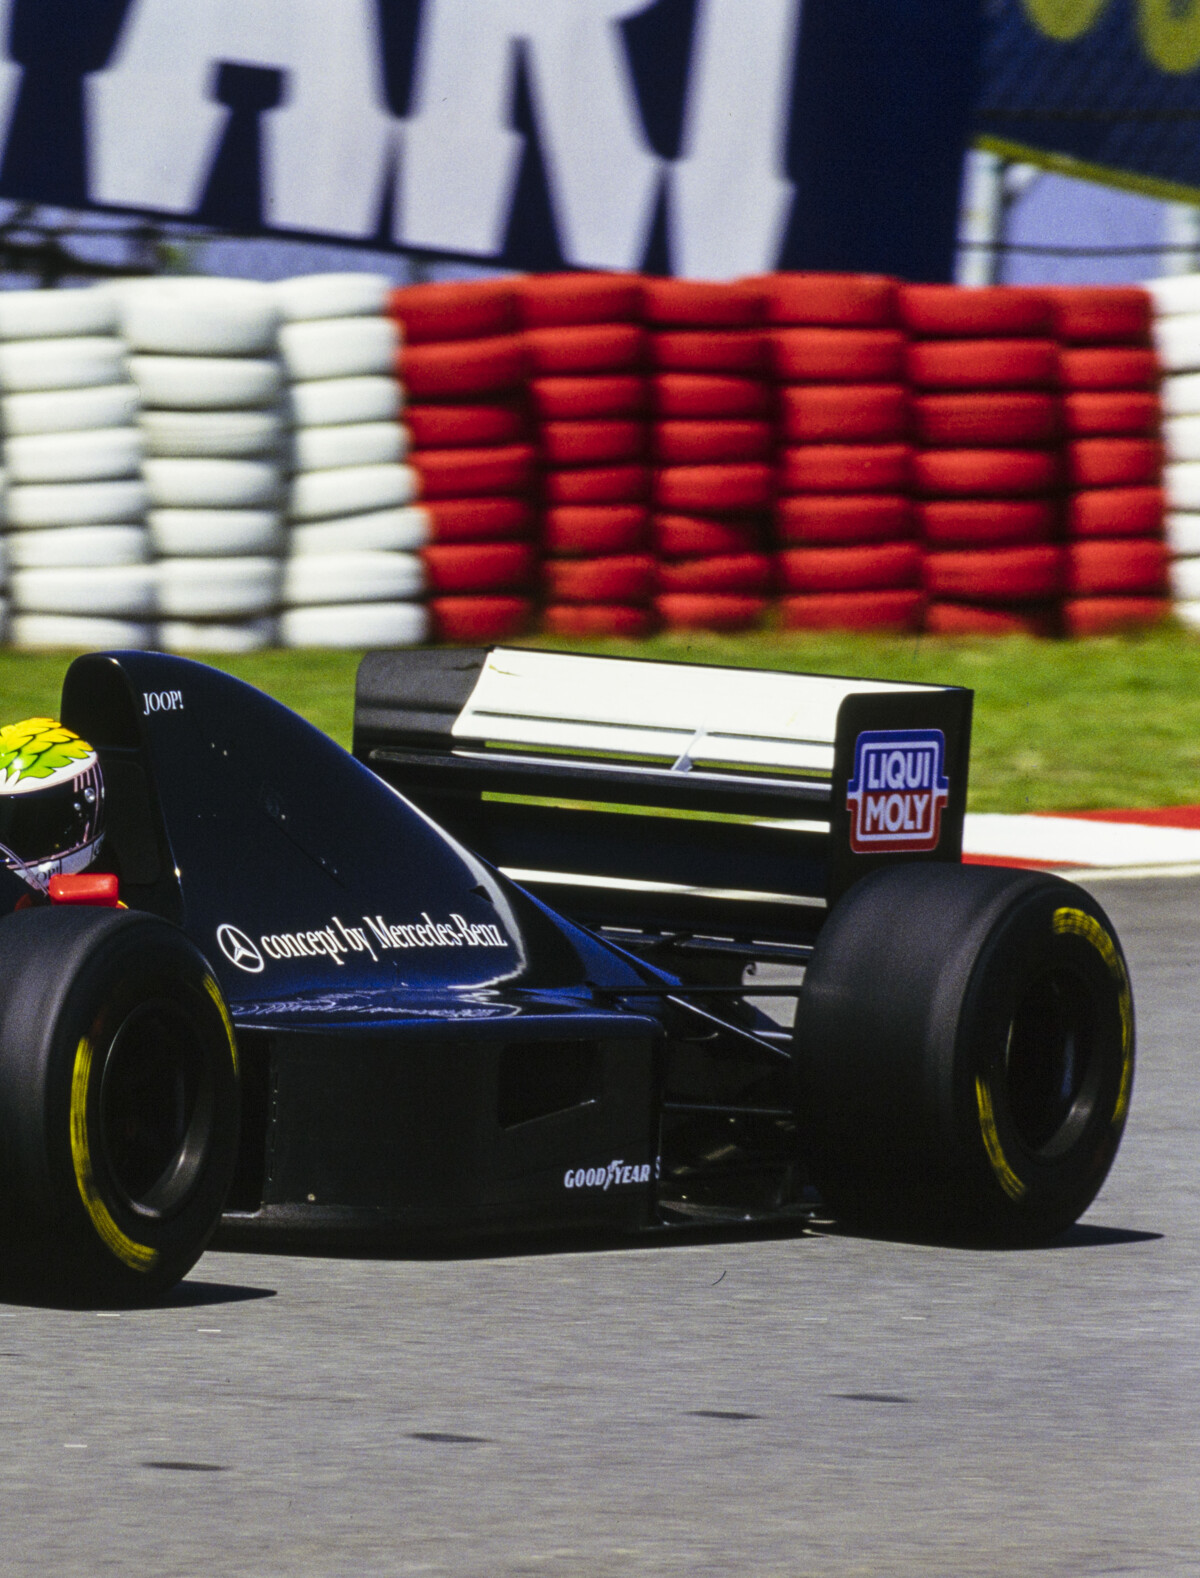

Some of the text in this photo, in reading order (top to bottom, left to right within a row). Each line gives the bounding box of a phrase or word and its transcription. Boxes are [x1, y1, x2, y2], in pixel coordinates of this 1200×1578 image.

[142, 690, 184, 715] JOOP!
[867, 750, 931, 790] LIQUI
[865, 793, 930, 832] MOLY
[260, 911, 509, 966] concept by Mercedes-Benz
